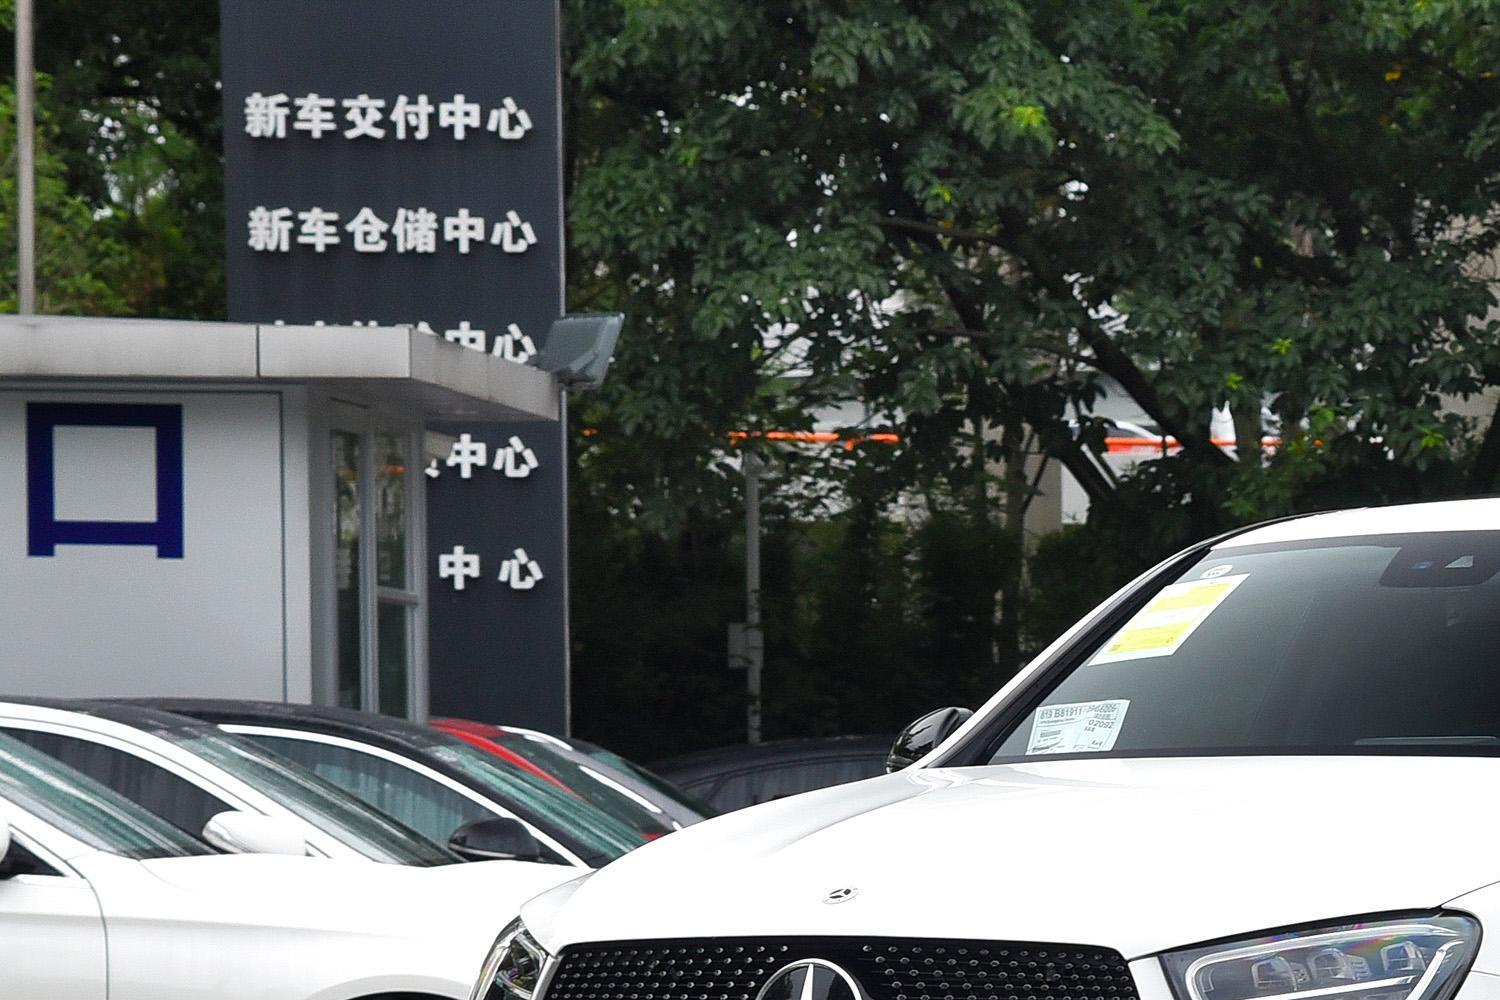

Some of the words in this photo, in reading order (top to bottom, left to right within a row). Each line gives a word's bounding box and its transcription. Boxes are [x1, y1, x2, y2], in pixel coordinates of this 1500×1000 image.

[243, 91, 533, 140] 新车交付中心
[247, 205, 538, 254] 新车仓储中心
[425, 433, 539, 479] 中心
